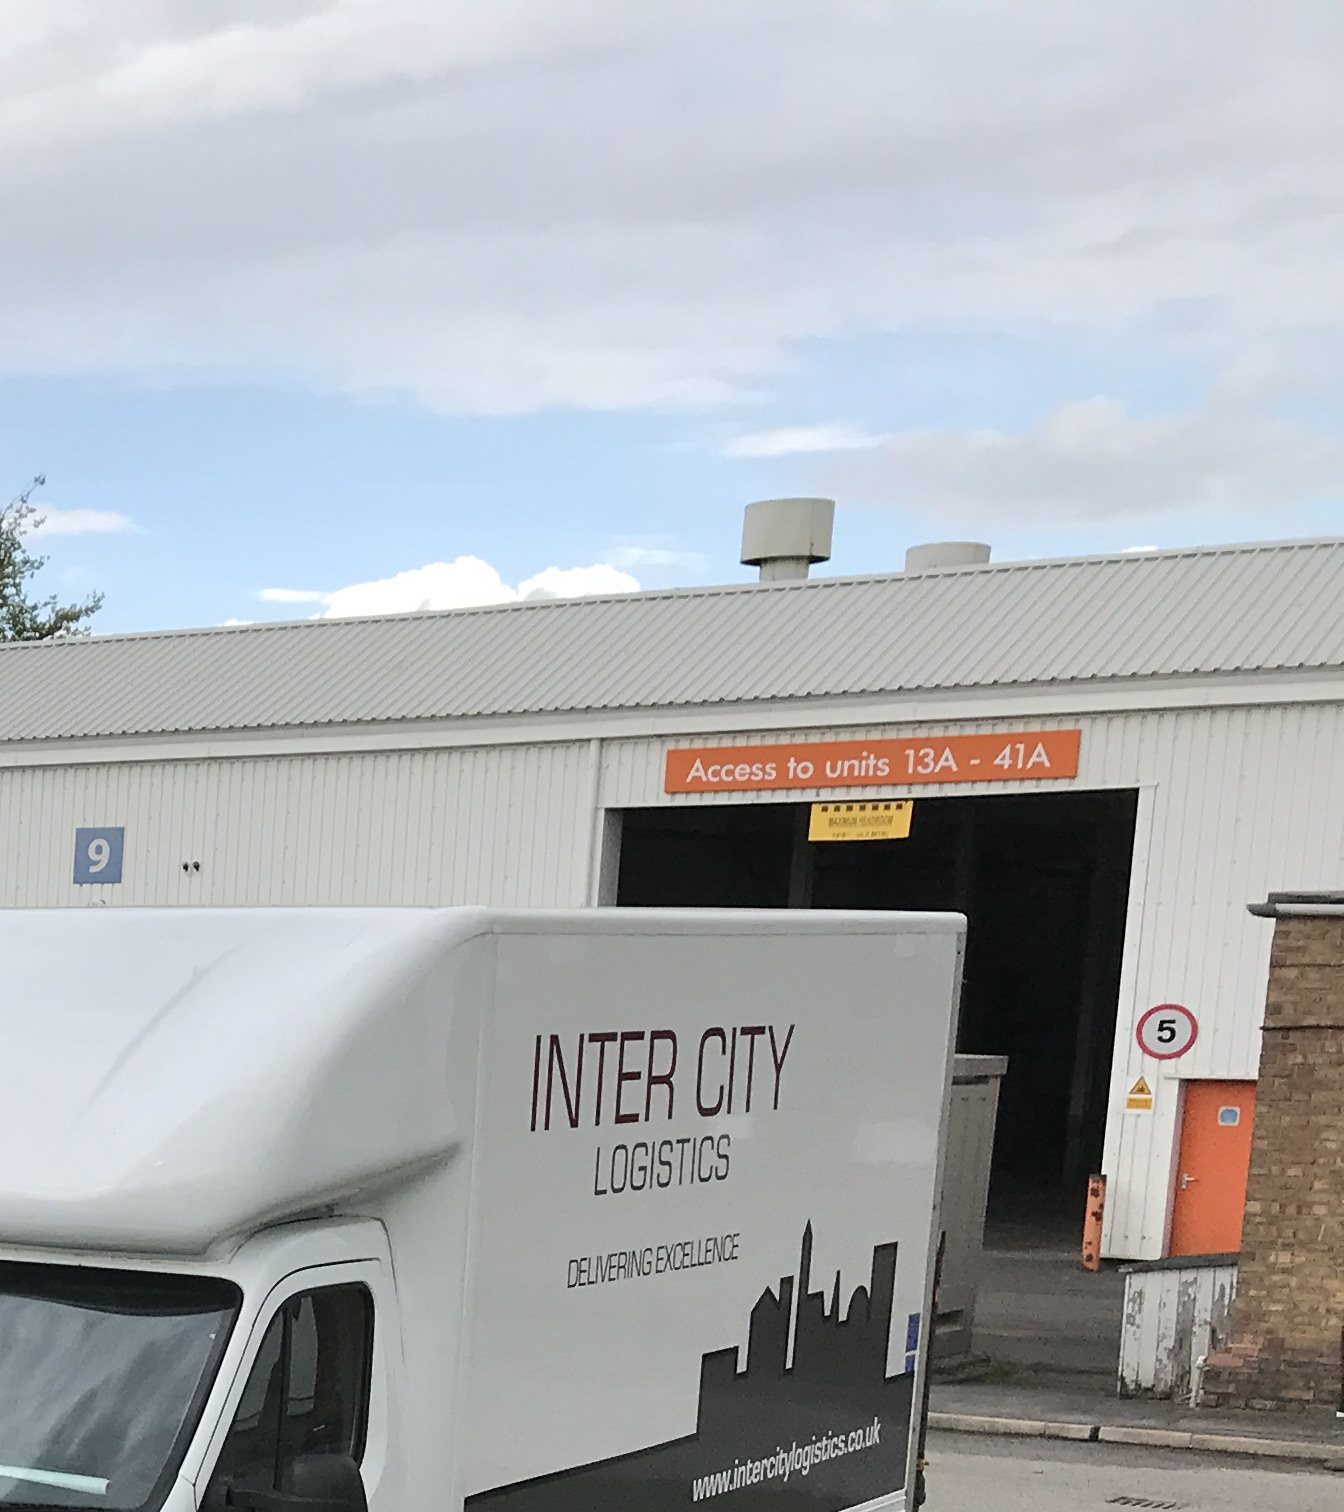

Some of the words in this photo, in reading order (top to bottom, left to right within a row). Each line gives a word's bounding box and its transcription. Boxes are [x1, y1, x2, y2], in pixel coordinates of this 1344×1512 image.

[685, 758, 777, 784] Access
[787, 756, 814, 780] to
[825, 749, 890, 779] units
[903, 747, 959, 776] 13A
[992, 742, 1052, 771] 41A
[86, 837, 111, 874] 9
[1157, 1019, 1176, 1043] 5
[529, 1028, 679, 1132] INTER
[694, 1023, 796, 1119] CITY
[593, 1133, 731, 1196] LOGISTICS
[567, 1247, 653, 1289] DELIVERING
[655, 1232, 741, 1275] EXCELLENCE
[692, 1416, 882, 1503] www.intercitylogistics.co.uk
